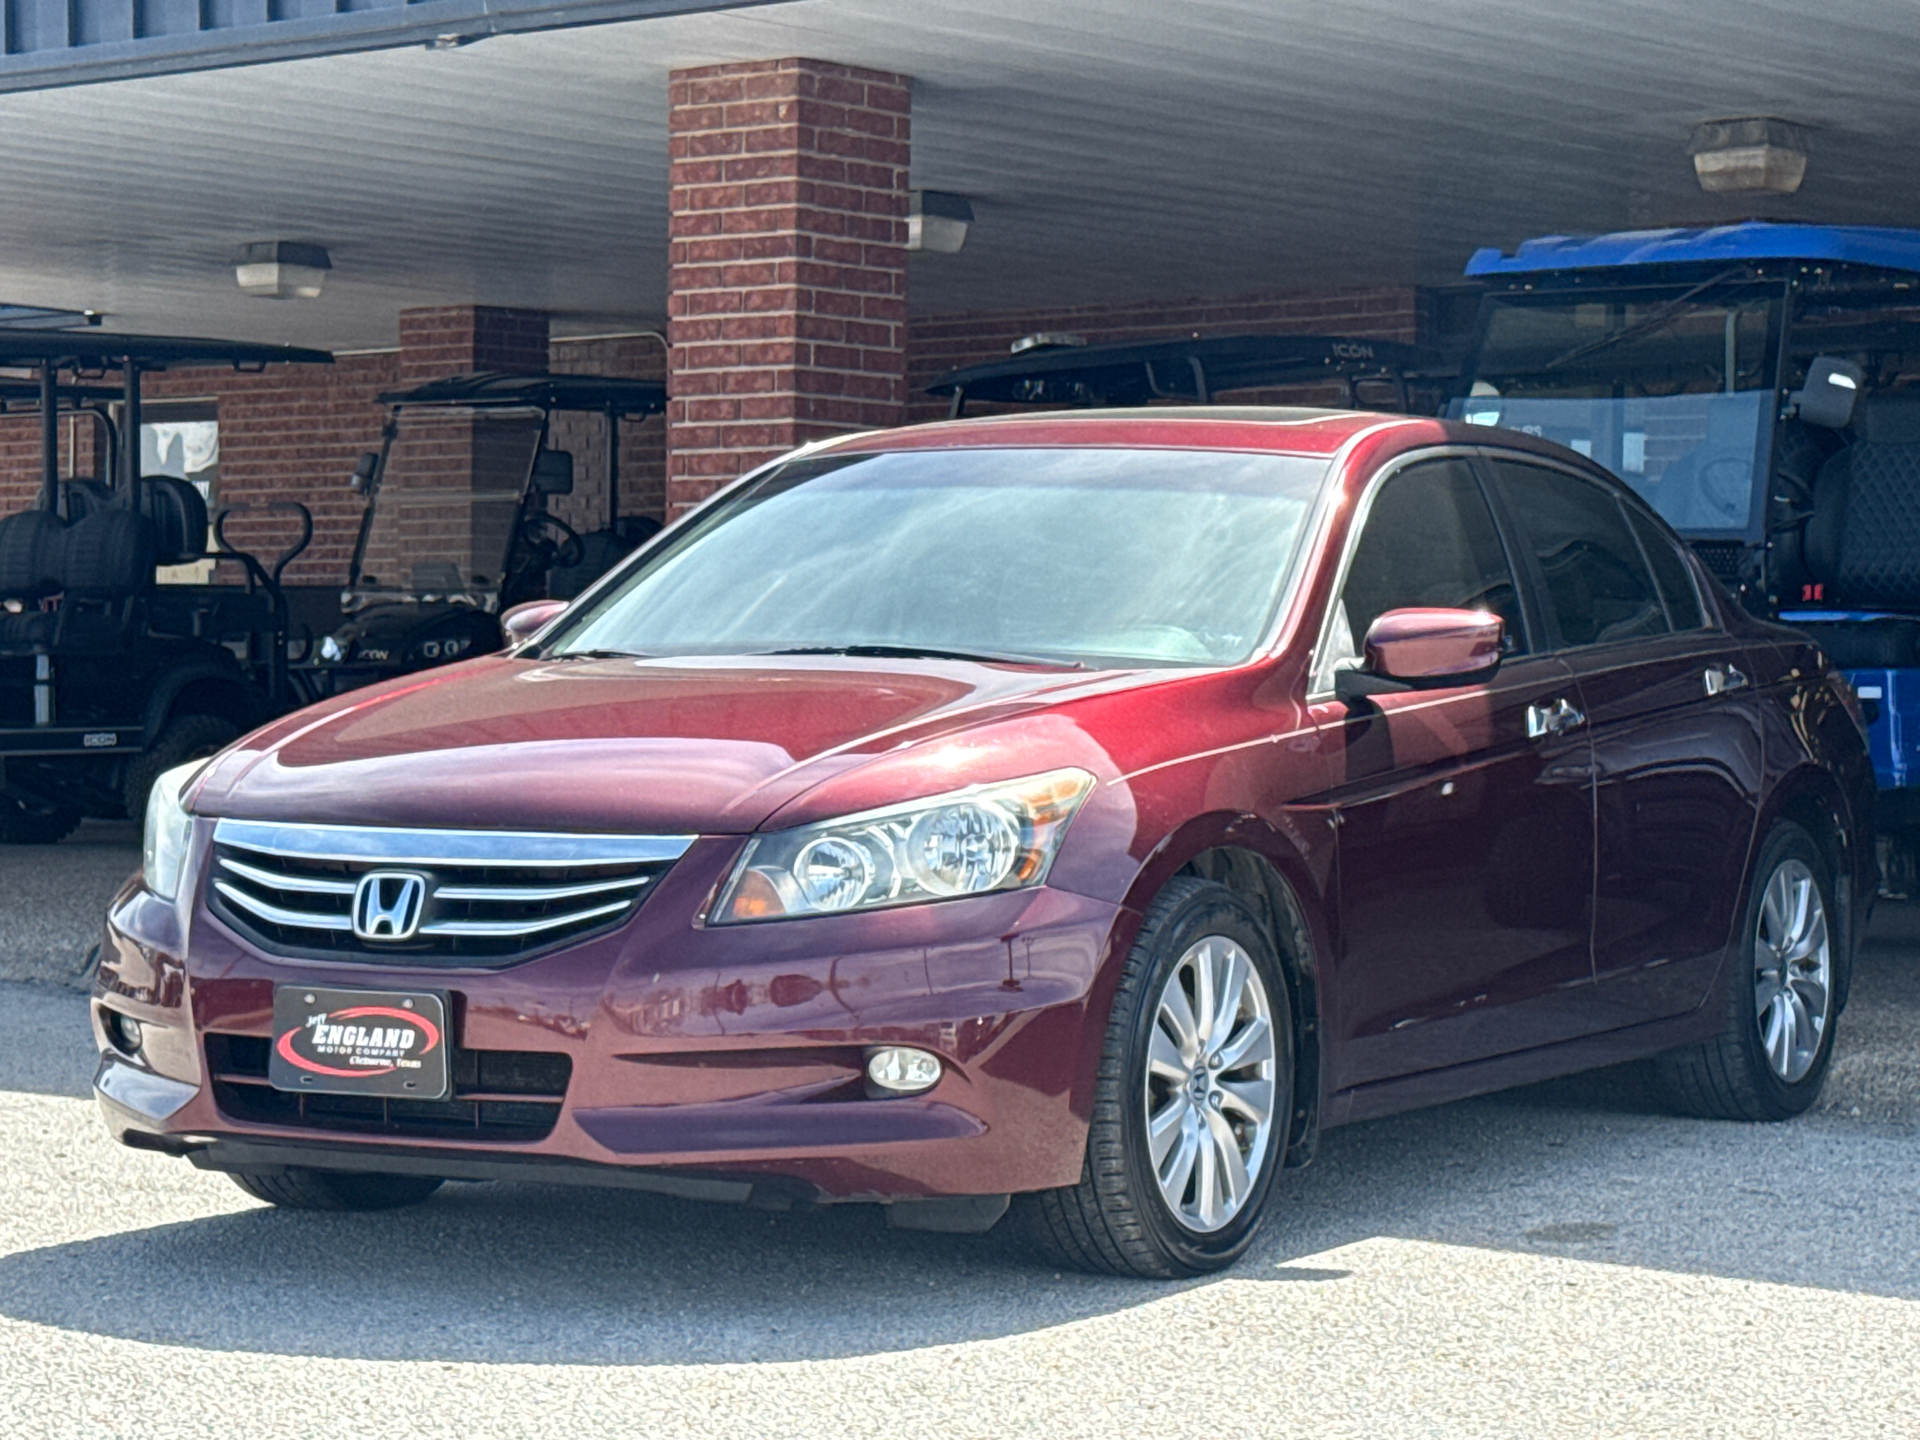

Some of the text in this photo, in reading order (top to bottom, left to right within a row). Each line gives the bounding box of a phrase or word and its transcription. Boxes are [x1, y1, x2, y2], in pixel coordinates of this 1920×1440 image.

[1332, 343, 1374, 359] ICON
[311, 1024, 416, 1050] ENGLAND
[317, 1045, 405, 1057] MOTOR COMPANY
